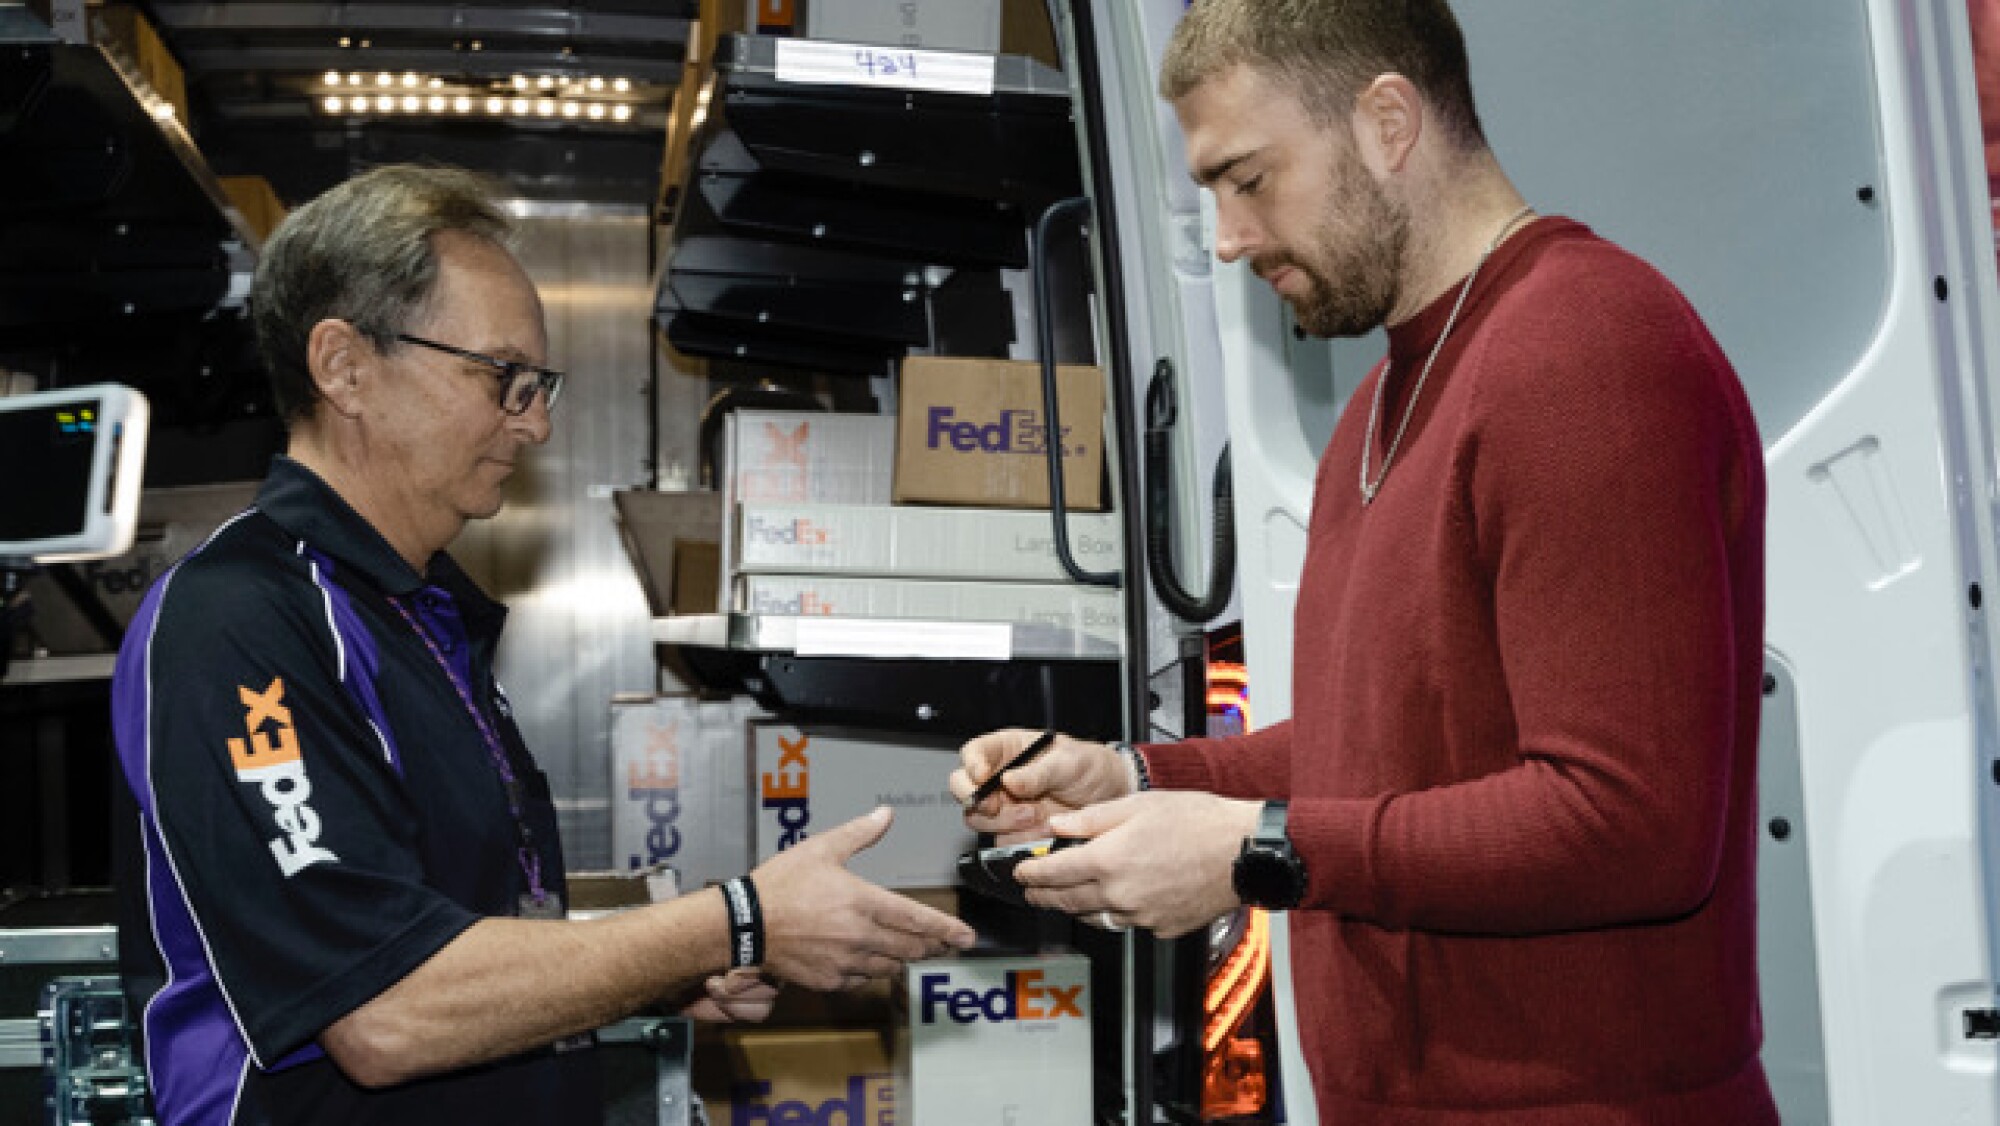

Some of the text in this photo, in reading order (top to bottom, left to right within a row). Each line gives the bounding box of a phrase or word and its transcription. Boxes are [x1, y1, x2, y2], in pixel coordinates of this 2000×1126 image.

[225, 674, 341, 877] FedEx
[762, 735, 809, 851] edEx
[921, 969, 1084, 1024] FedEx
